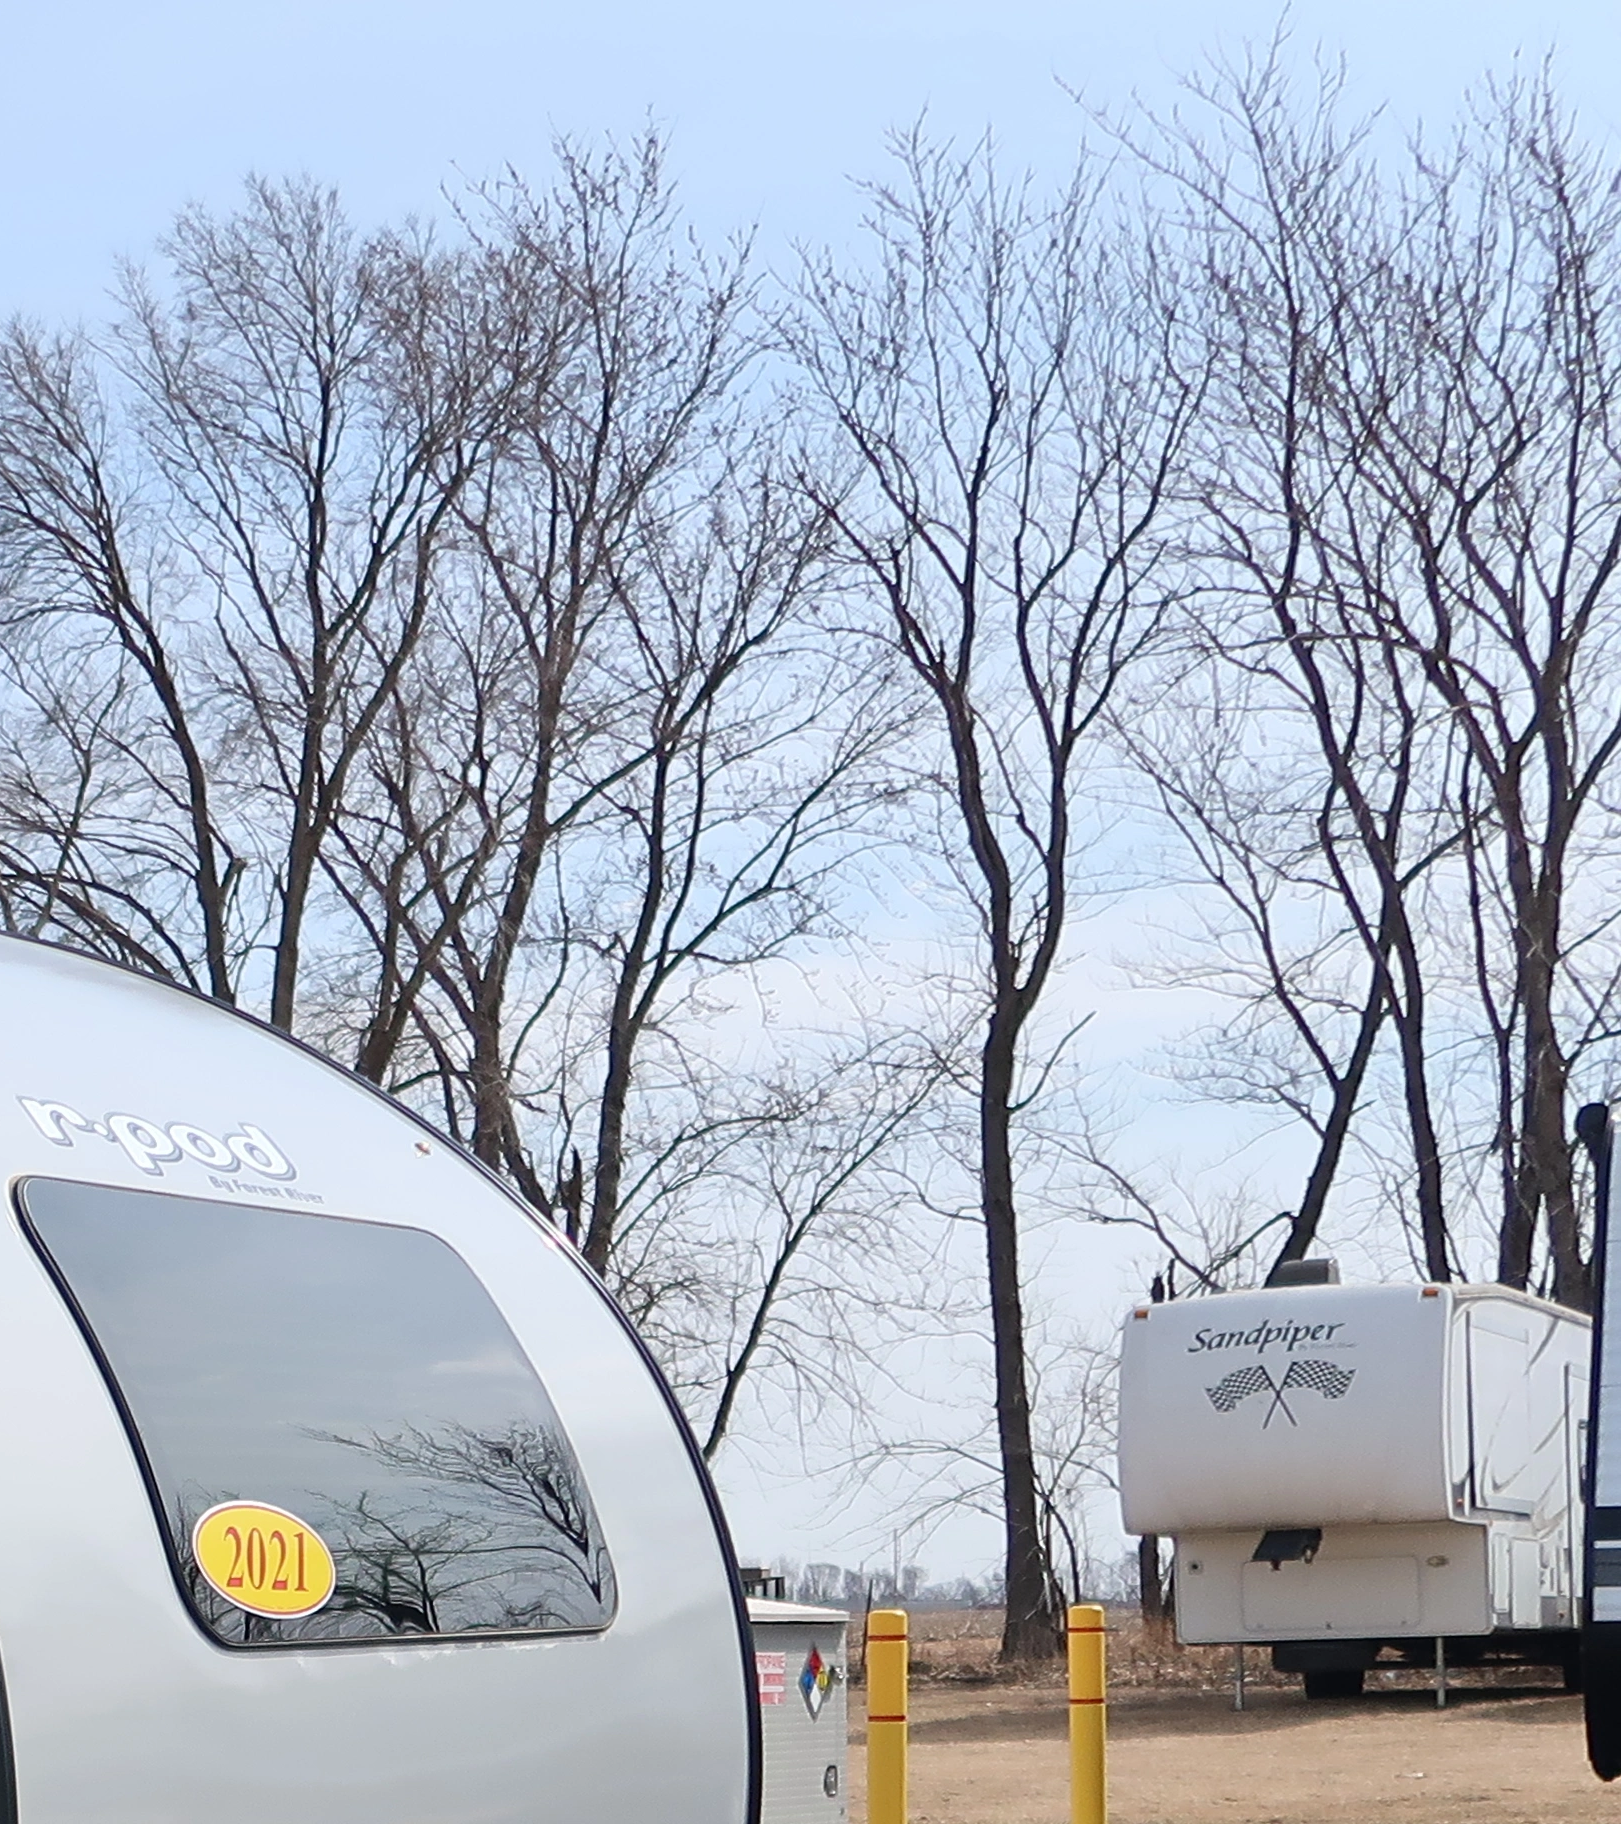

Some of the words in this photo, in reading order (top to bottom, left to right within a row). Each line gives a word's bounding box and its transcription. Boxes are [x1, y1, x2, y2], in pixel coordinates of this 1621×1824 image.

[209, 1175, 231, 1194] By
[232, 1178, 284, 1198] Forest
[286, 1187, 324, 1204] River
[1187, 1317, 1346, 1354] Sandpiper
[223, 1526, 309, 1592] 2021
